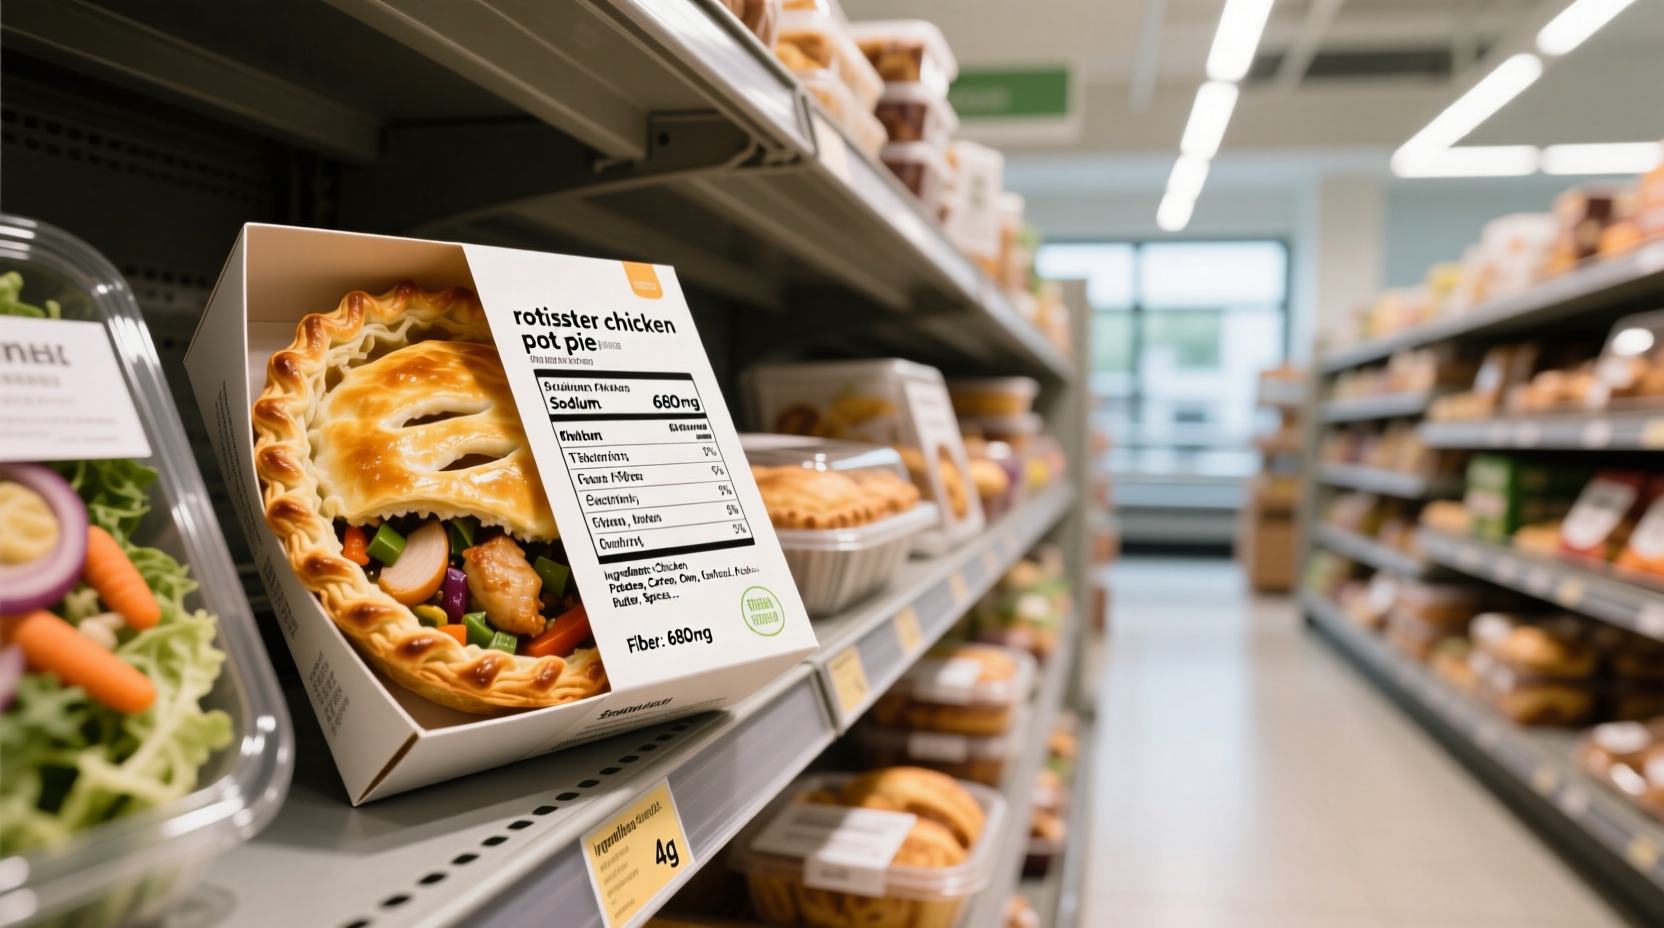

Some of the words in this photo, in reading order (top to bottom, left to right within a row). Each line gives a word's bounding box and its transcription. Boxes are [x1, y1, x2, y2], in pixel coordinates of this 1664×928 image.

[513, 306, 599, 329] rotisster
[604, 311, 677, 334] chicken
[521, 332, 561, 354] pot
[564, 333, 598, 355] pie
[652, 394, 700, 411] 680mg
[655, 838, 680, 868] 4g
